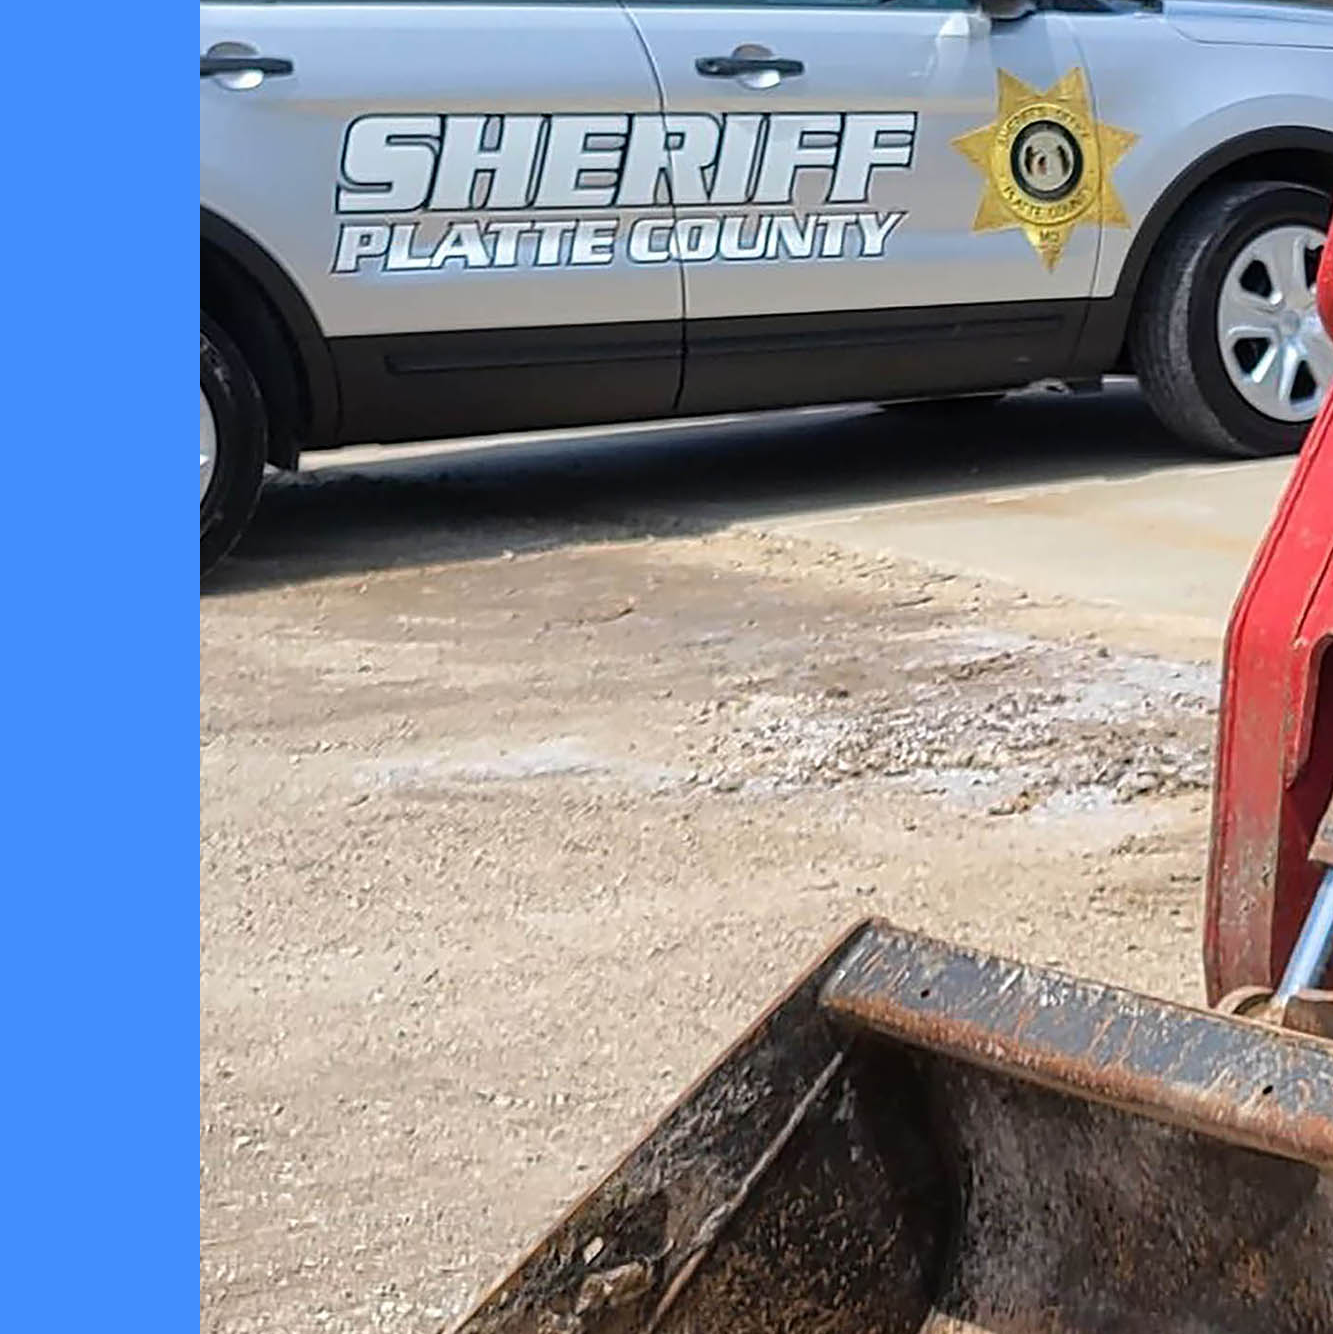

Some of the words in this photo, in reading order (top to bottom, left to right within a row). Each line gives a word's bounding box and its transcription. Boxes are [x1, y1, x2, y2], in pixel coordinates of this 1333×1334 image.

[335, 111, 918, 213] SHERIFF
[331, 213, 617, 274] PLATTE
[624, 211, 909, 265] COUNTY
